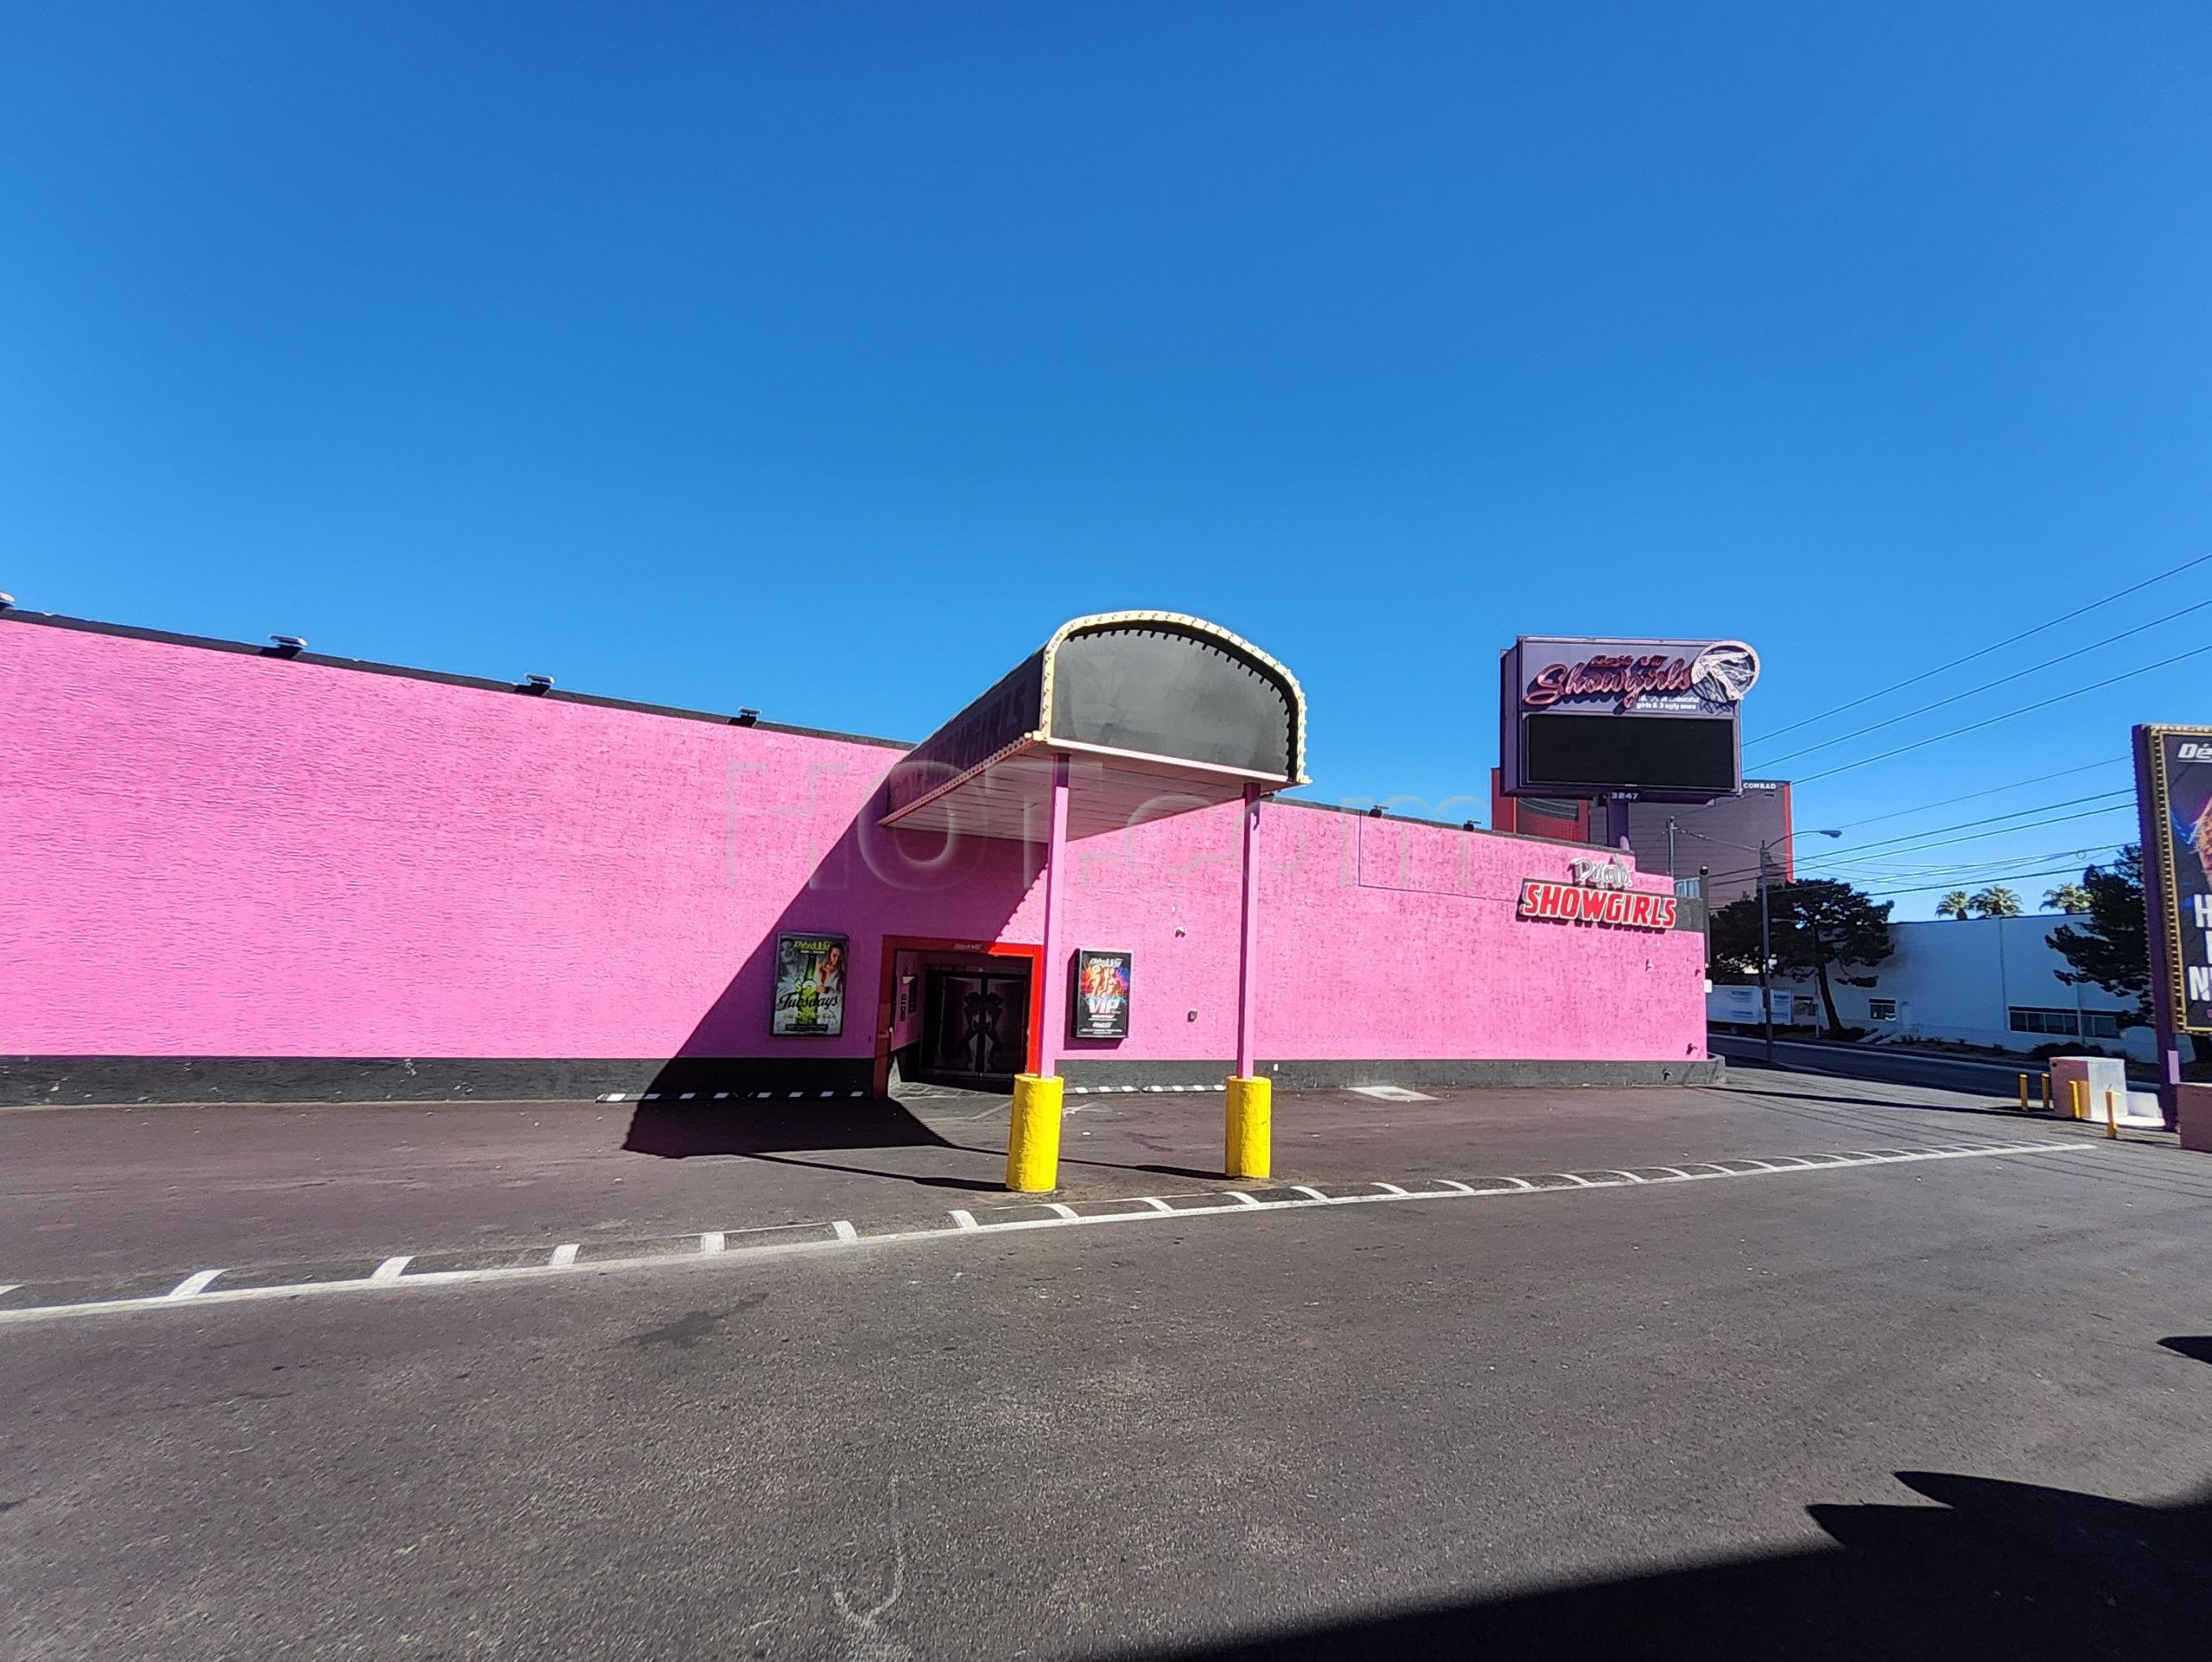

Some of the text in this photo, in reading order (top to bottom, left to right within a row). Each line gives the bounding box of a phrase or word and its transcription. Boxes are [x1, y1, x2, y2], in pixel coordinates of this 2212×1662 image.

[1524, 659, 1693, 709] Showgirls
[1523, 882, 1677, 929] SHOWGIRLS
[778, 991, 838, 1010] Tuesdays
[1089, 997, 1121, 1014] VIP
